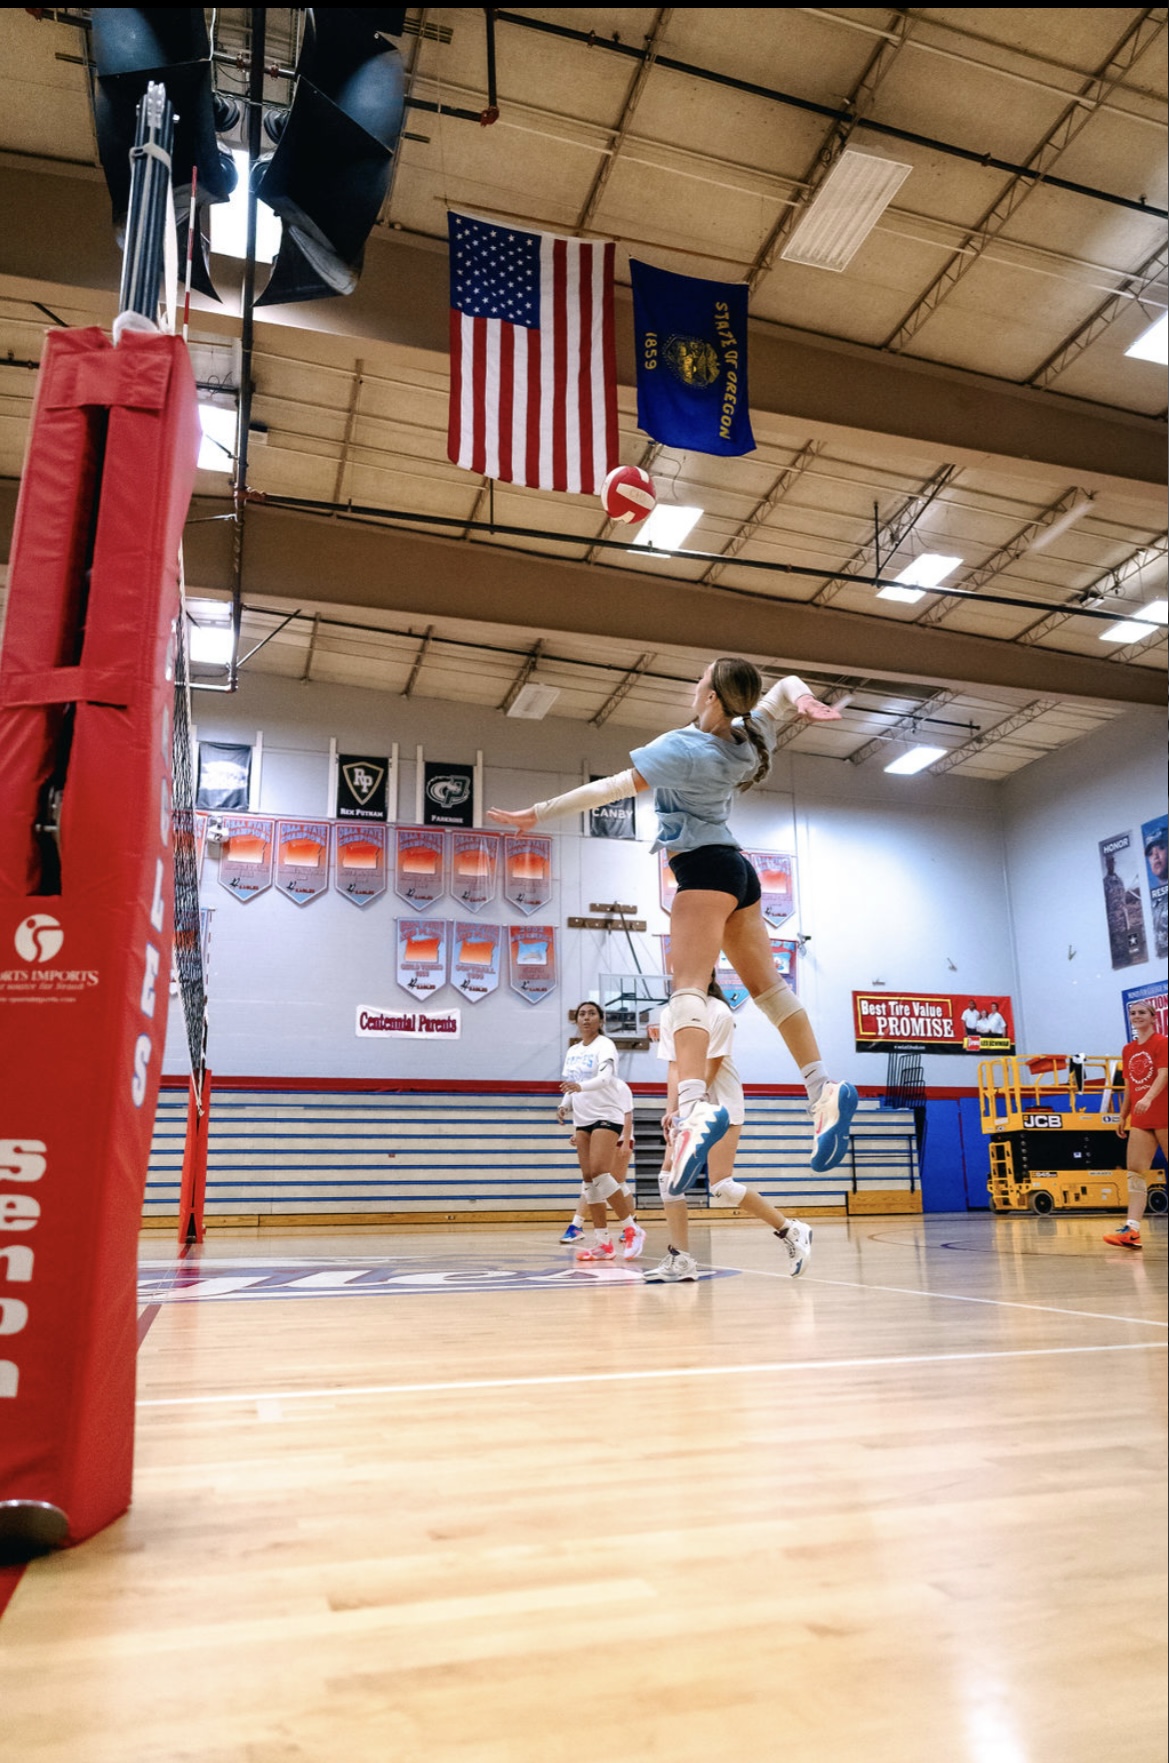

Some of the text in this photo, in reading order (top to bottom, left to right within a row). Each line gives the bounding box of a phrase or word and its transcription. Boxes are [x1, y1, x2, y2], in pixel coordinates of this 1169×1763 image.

[644, 332, 658, 371] 1859
[714, 302, 739, 439] STATE OF OREGON
[353, 768, 373, 793] RP
[340, 807, 384, 818] REX PUTNAM
[591, 807, 634, 819] CANBY
[1103, 837, 1130, 854] HONOR
[31, 970, 99, 986] IMPORTS
[860, 1000, 943, 1018] Best Tire Value
[360, 1011, 457, 1033] Centennial Parents
[876, 1016, 955, 1038] PROMISE
[1024, 1115, 1062, 1128] JCB
